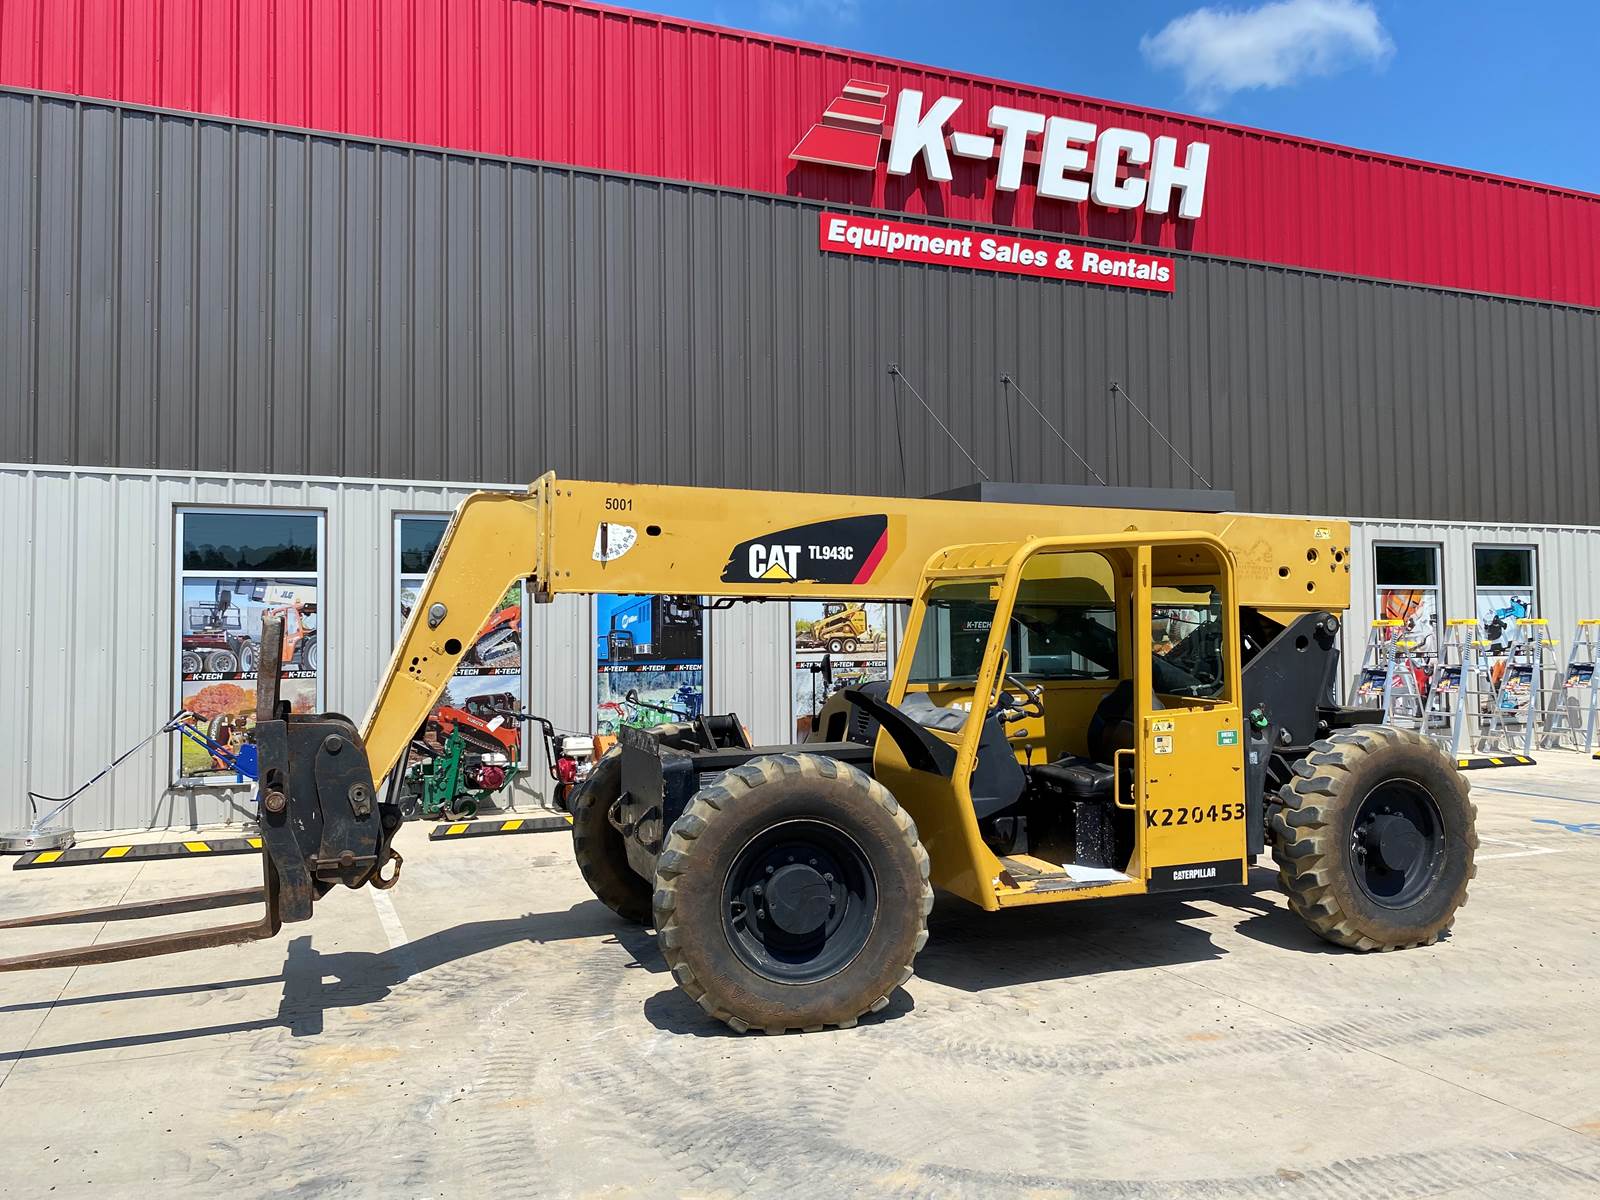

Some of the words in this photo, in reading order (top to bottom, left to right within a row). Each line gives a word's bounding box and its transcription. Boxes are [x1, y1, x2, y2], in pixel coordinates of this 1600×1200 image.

[887, 88, 1210, 219] K-TECH
[828, 219, 971, 258] Equipment
[979, 239, 1048, 268] Sales
[1055, 248, 1074, 271] &
[1082, 254, 1170, 283] Rentals
[605, 498, 632, 511] 5001
[749, 544, 801, 579] CAT
[808, 545, 853, 560] TL943C
[281, 591, 294, 599] JLG
[967, 621, 992, 629] K-TECH
[1145, 803, 1245, 828] K220453
[1173, 867, 1216, 880] CATERPILLAR
